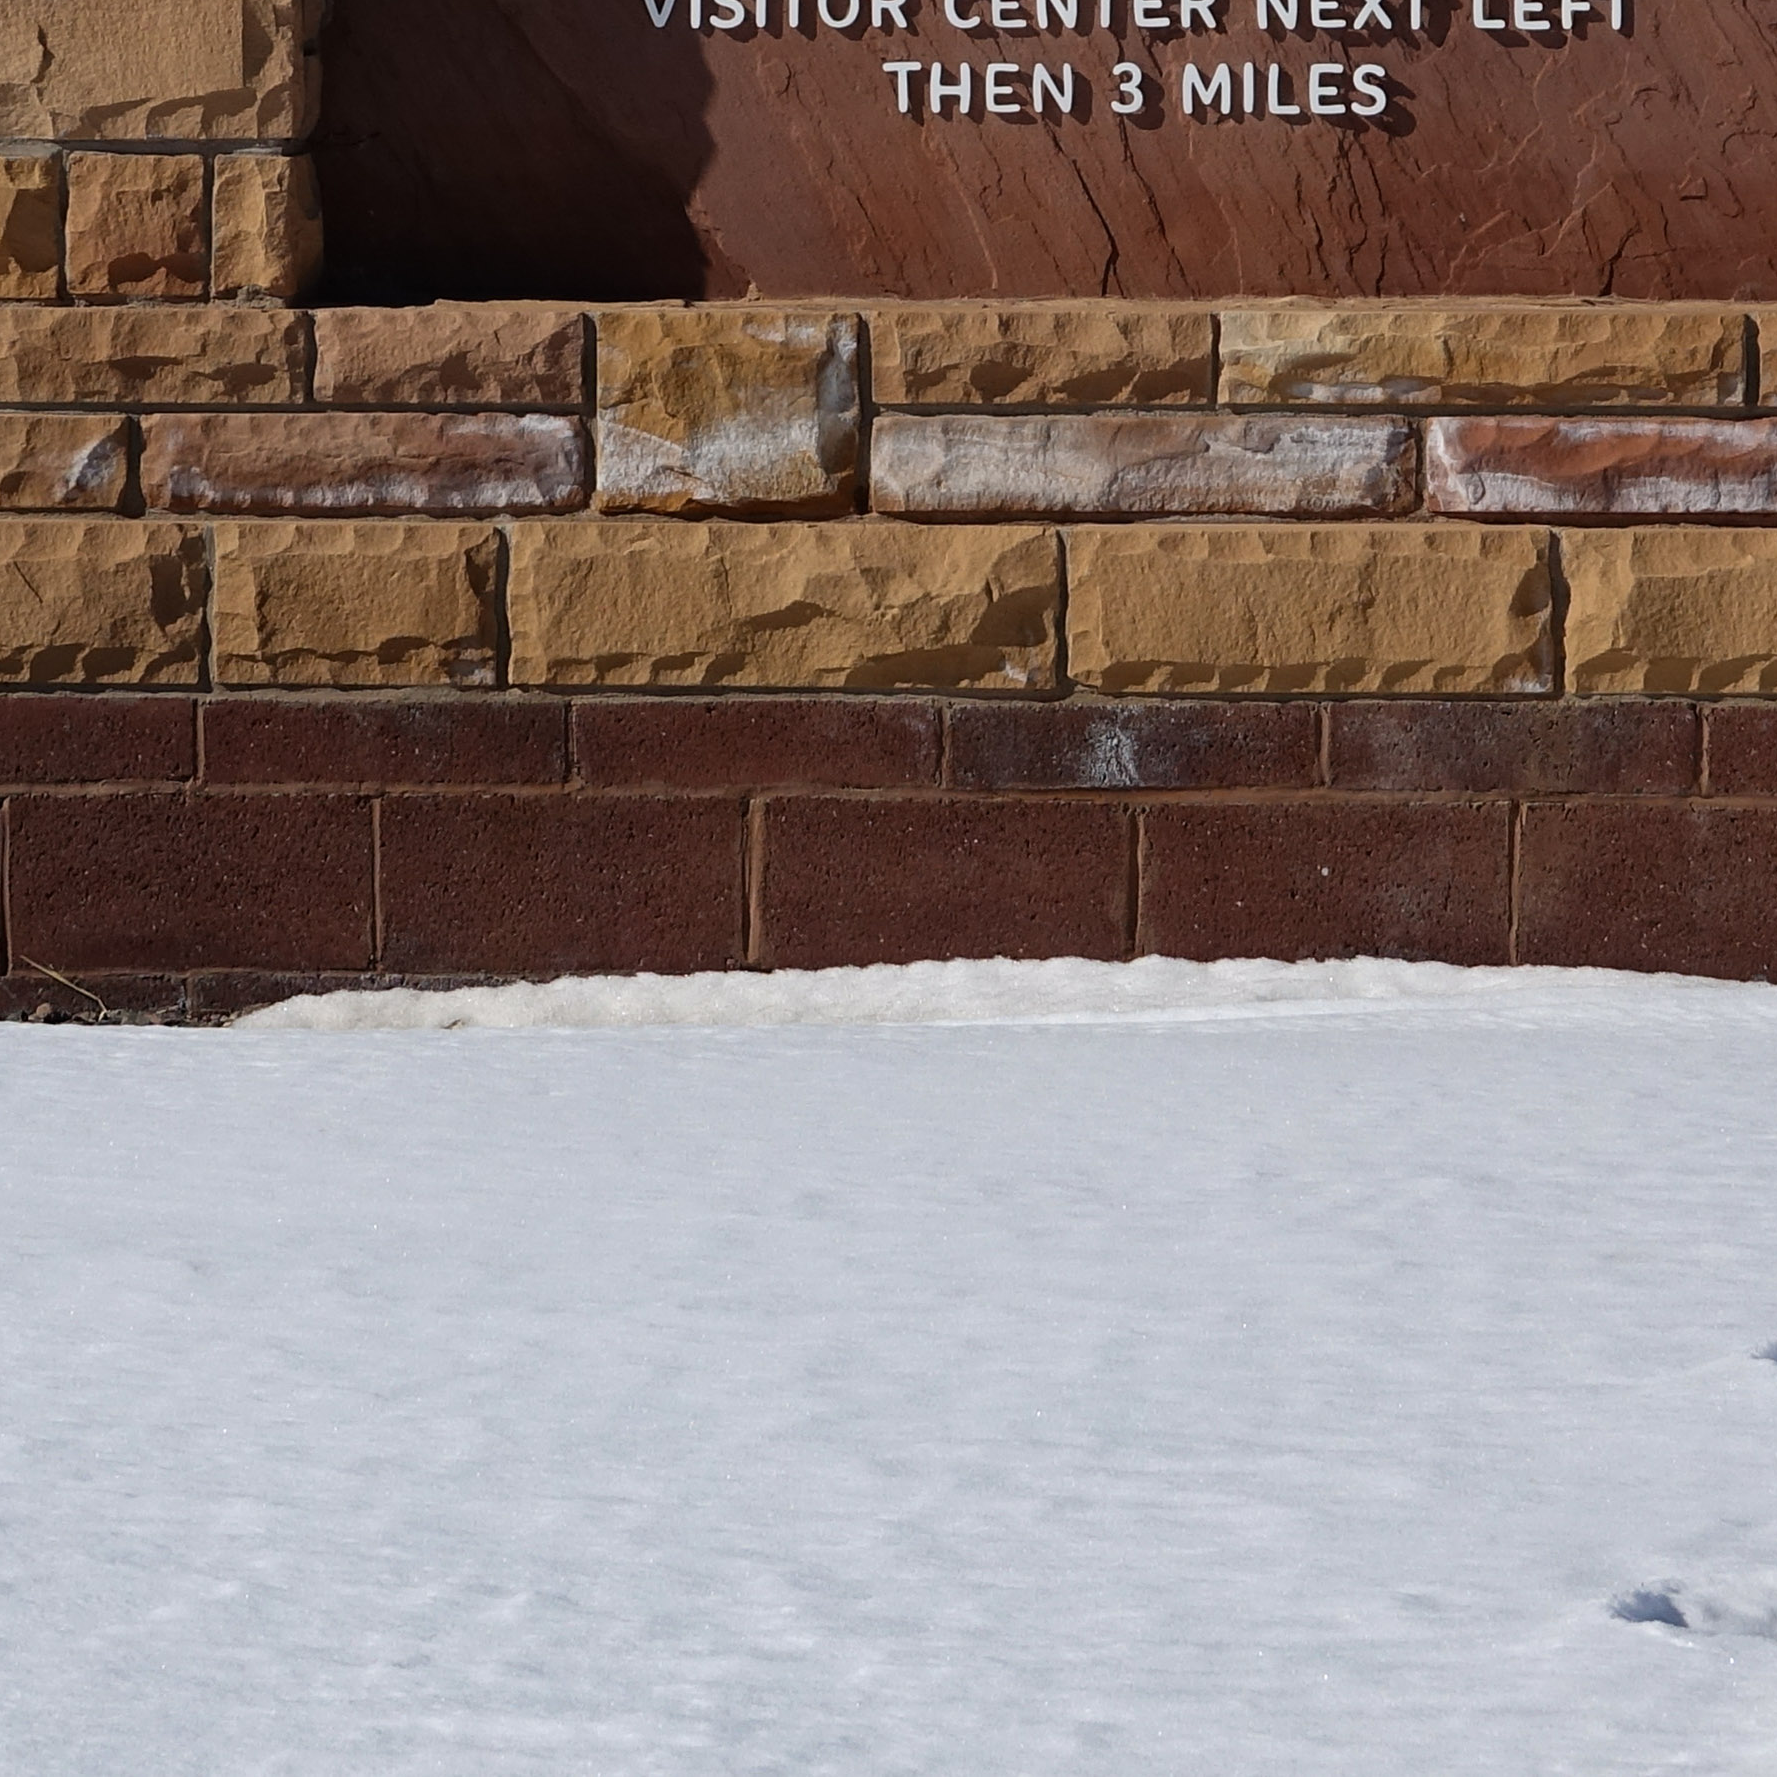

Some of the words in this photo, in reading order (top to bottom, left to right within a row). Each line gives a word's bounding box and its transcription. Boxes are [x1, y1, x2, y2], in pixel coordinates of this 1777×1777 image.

[886, 62, 1072, 113] THEN
[1114, 63, 1143, 113] 3
[1184, 64, 1386, 115] MILES
